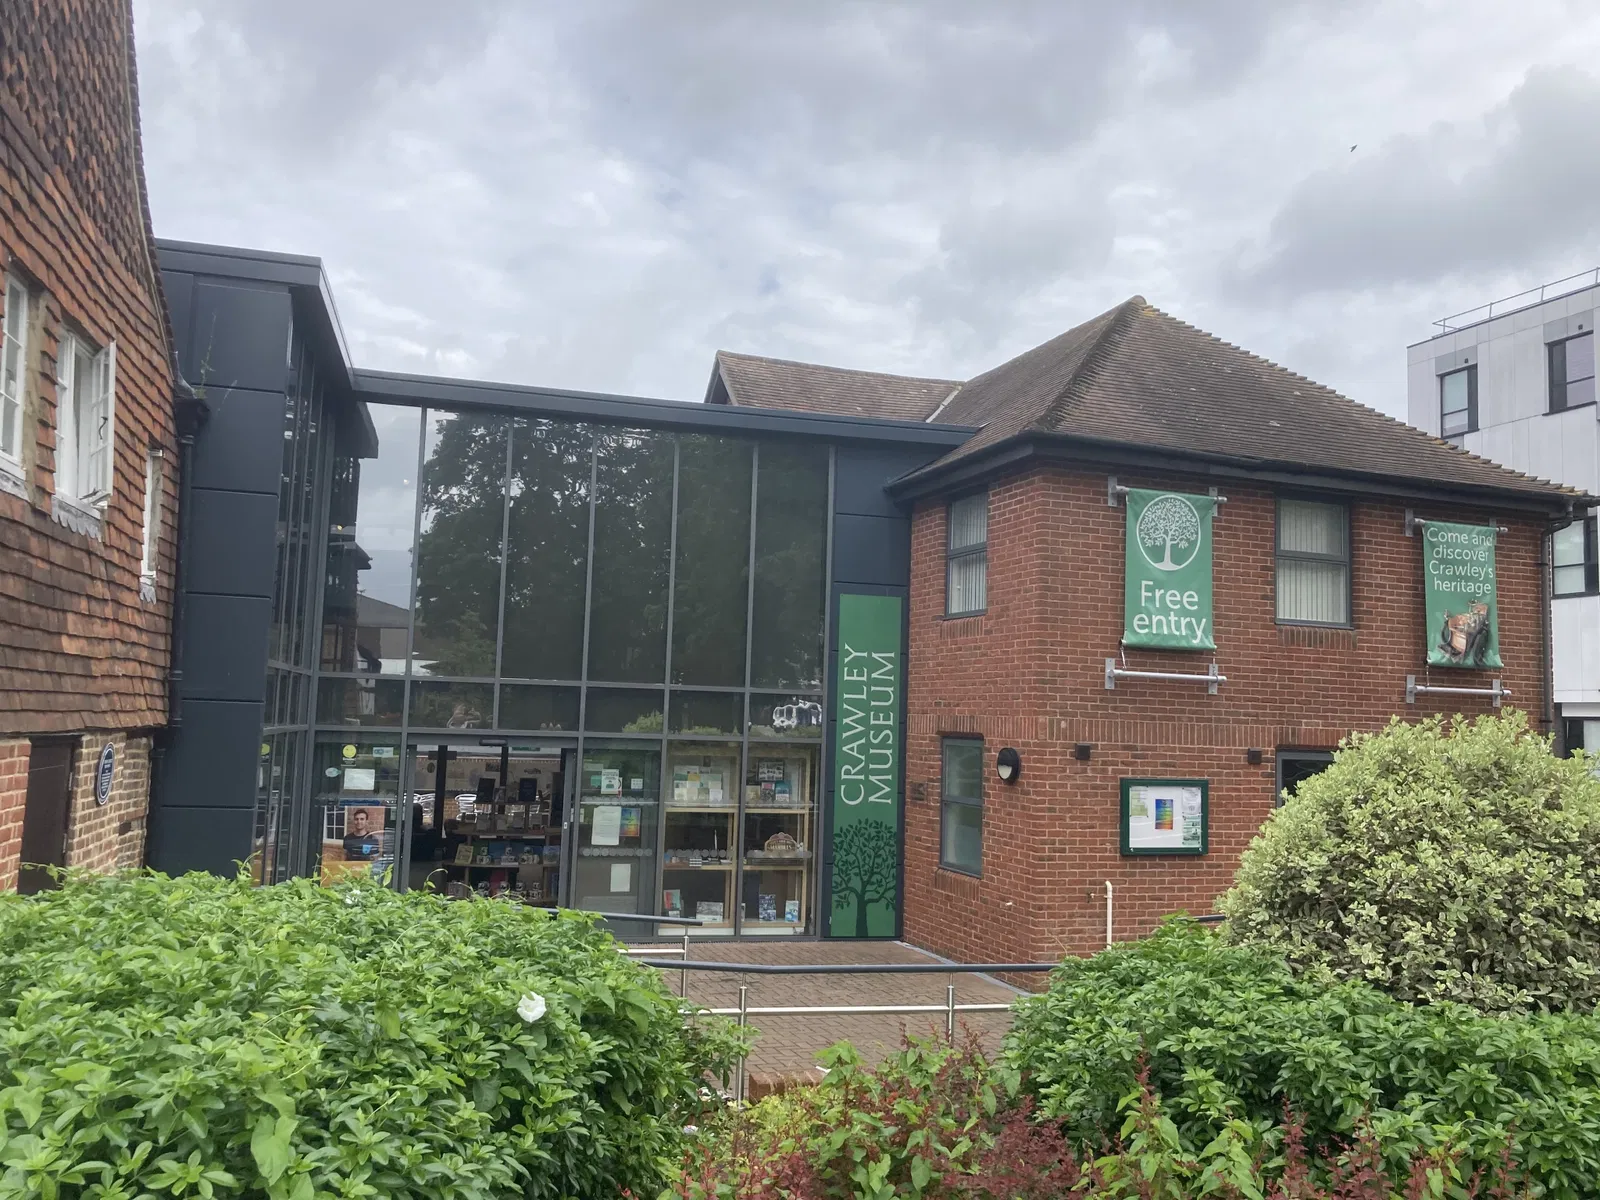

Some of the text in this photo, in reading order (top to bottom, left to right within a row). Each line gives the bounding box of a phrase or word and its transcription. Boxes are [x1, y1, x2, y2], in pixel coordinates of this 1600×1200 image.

[1427, 527, 1493, 546] Come and
[1433, 545, 1489, 561] discover
[1429, 560, 1493, 580] Crawley's
[1141, 580, 1199, 610] Free
[1434, 577, 1491, 597] heritage
[1133, 611, 1207, 644] entry
[841, 642, 868, 805] CRAWLEY
[868, 652, 895, 804] MUSEUM
